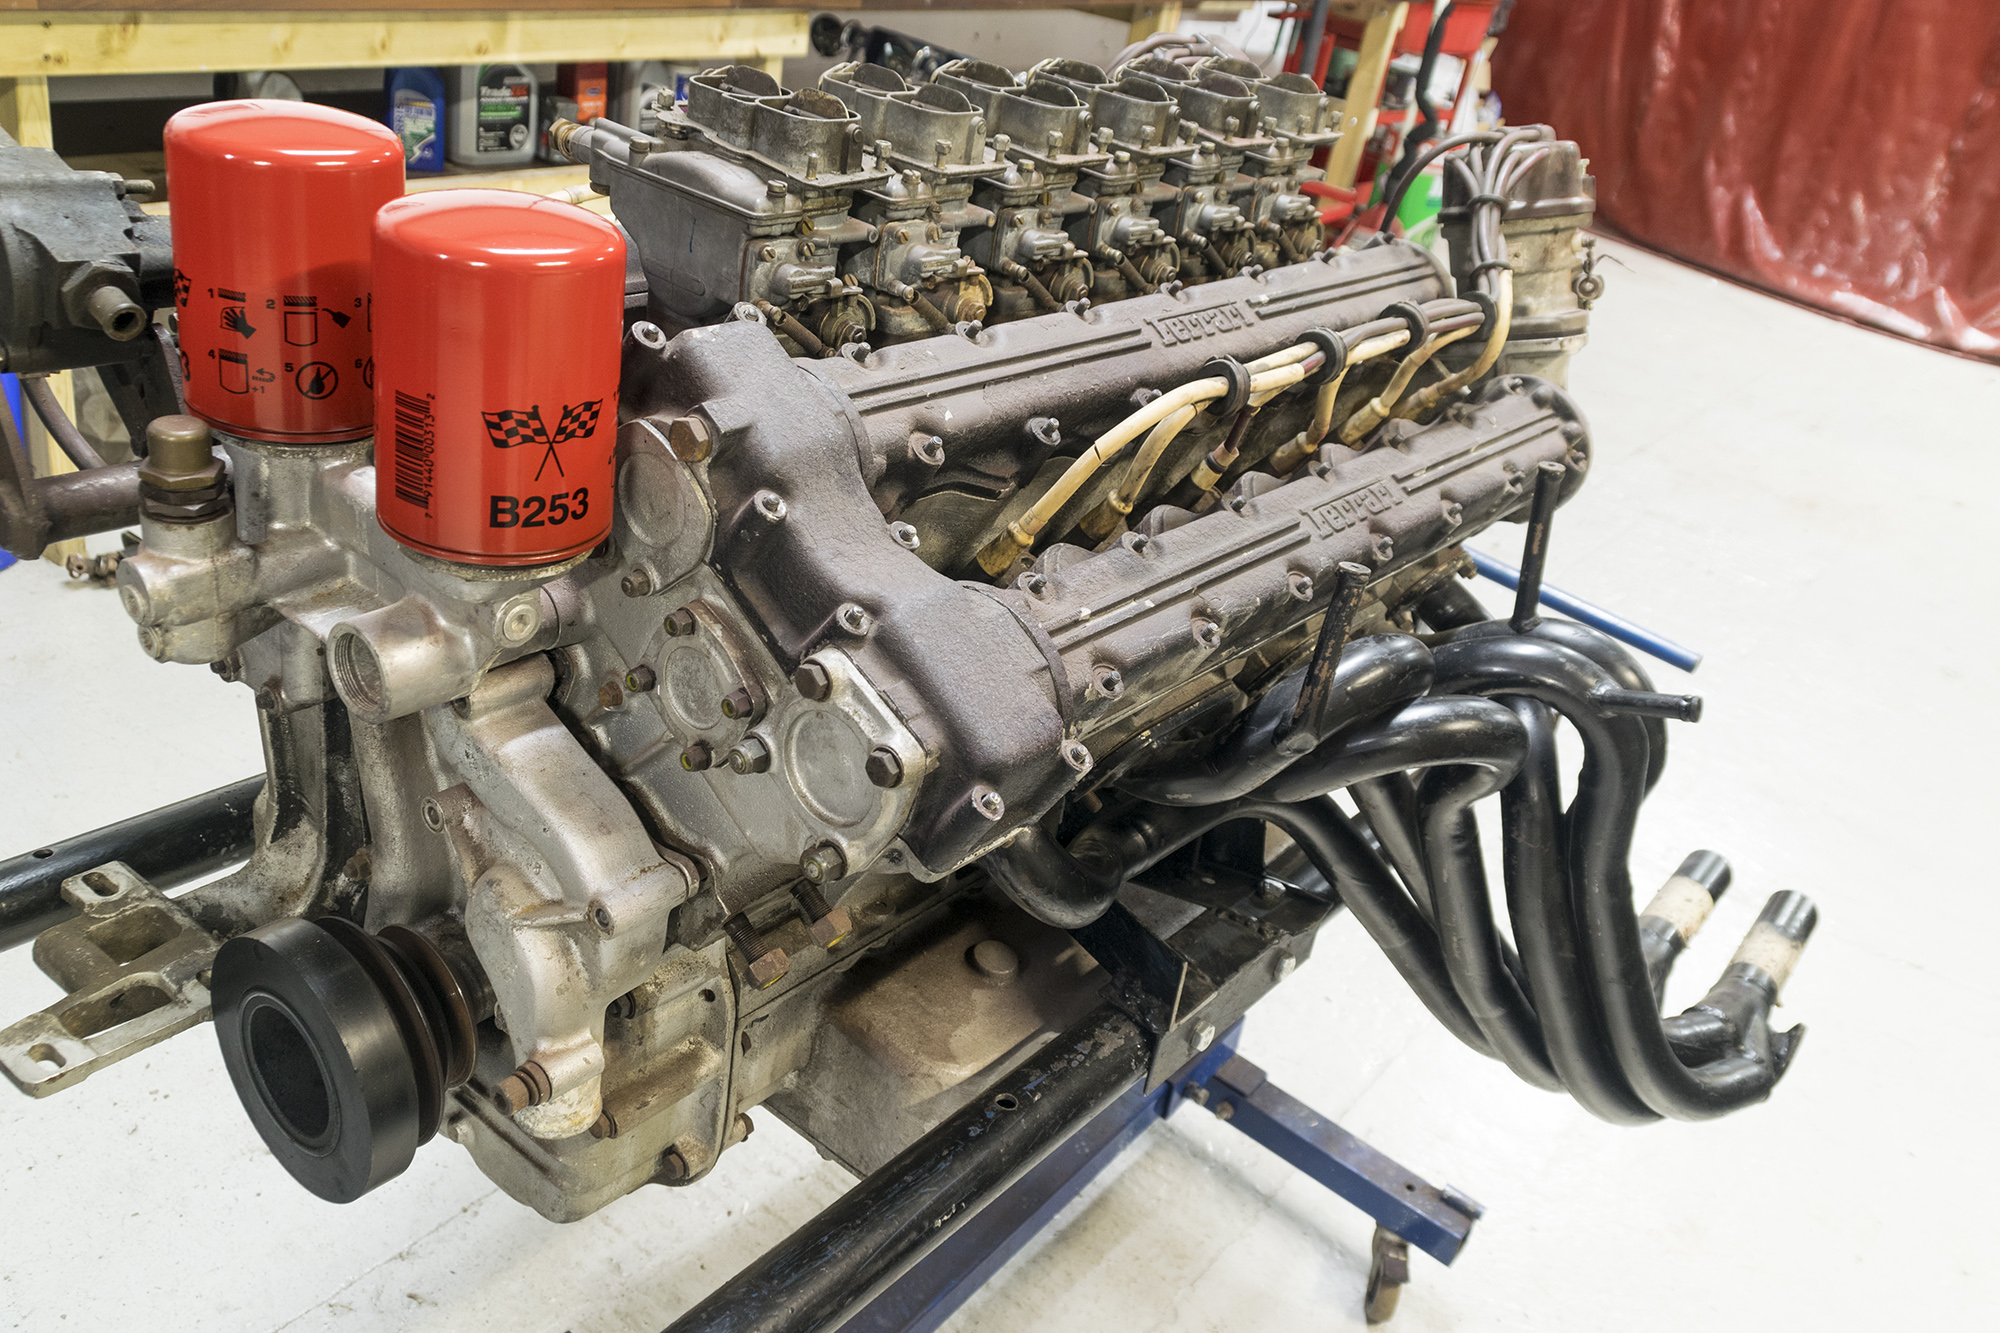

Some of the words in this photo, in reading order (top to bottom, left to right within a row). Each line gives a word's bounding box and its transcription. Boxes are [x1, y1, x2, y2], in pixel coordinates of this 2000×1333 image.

[207, 288, 214, 299] 1
[265, 299, 276, 310] 2
[354, 298, 362, 308] 3
[1143, 300, 1255, 347] Ferrari
[208, 349, 216, 360] 4
[284, 362, 294, 373] 5
[354, 358, 363, 369] 6
[489, 487, 589, 529] B253
[1298, 478, 1404, 541] Ferrari
